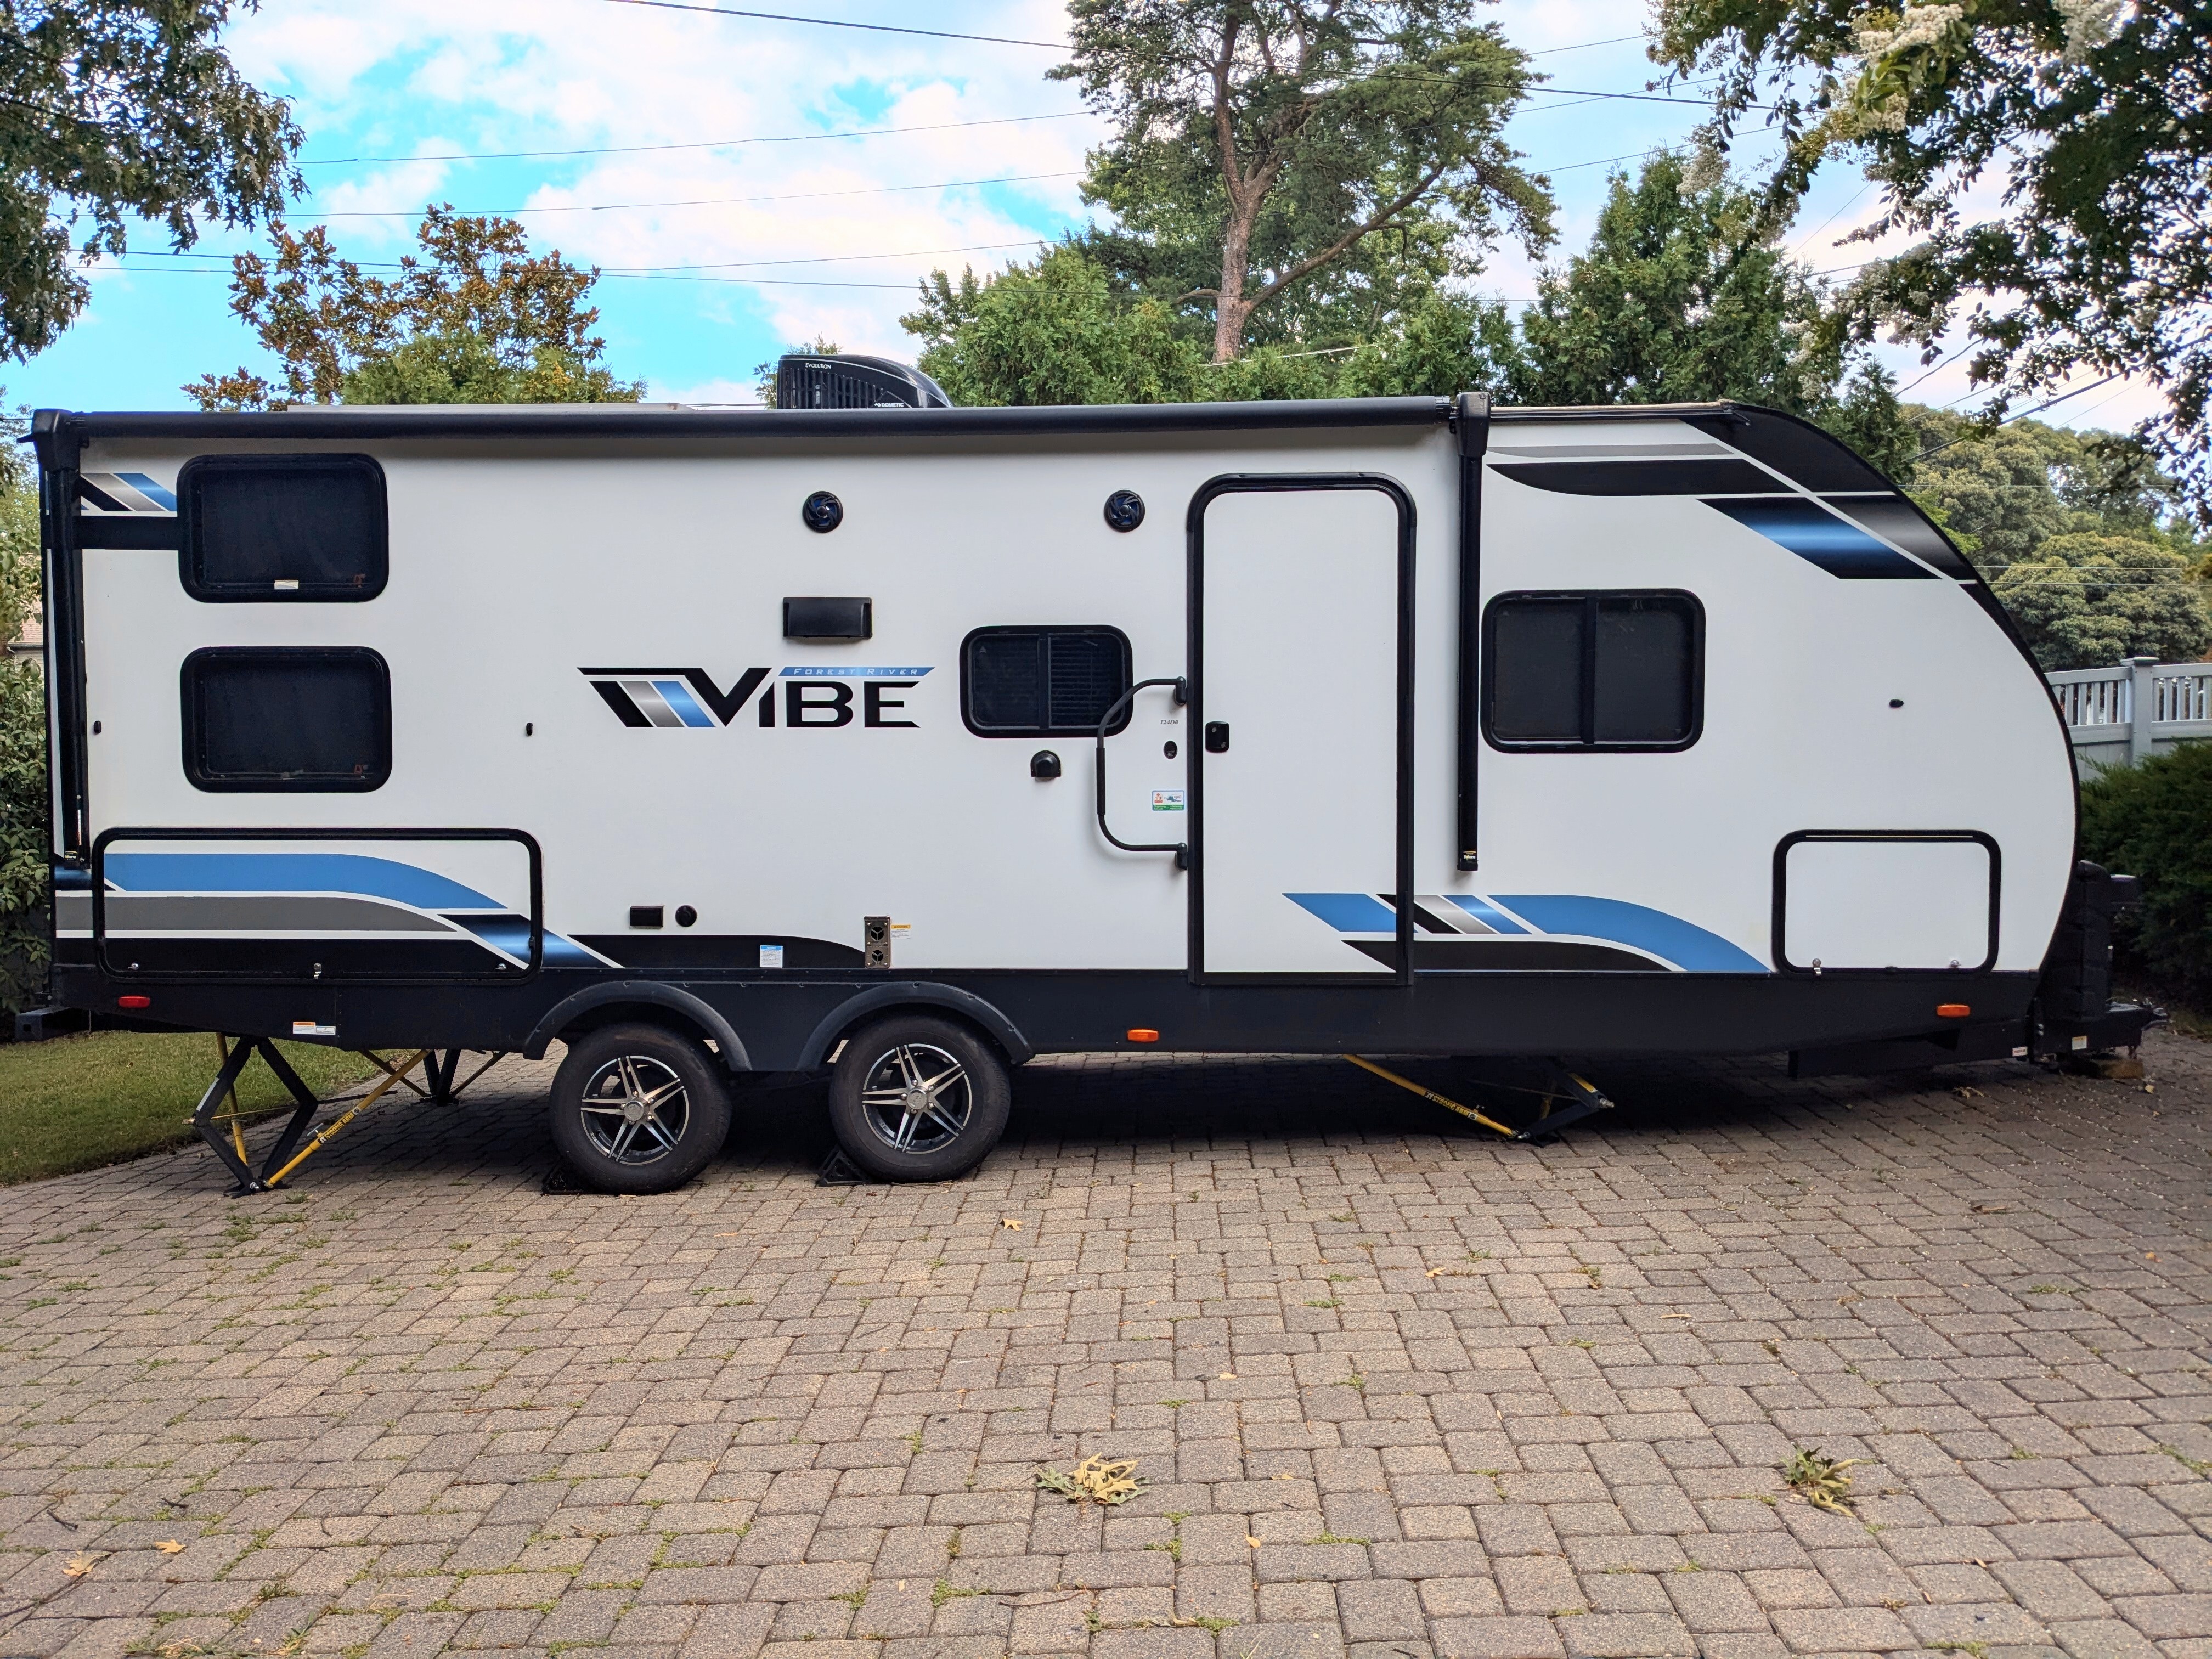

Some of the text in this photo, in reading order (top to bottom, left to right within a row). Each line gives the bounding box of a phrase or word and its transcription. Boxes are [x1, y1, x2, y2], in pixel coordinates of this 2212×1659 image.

[577, 667, 921, 727] VIBE
[1432, 1095, 1456, 1110] STRONG
[324, 1121, 346, 1139] STRONG
